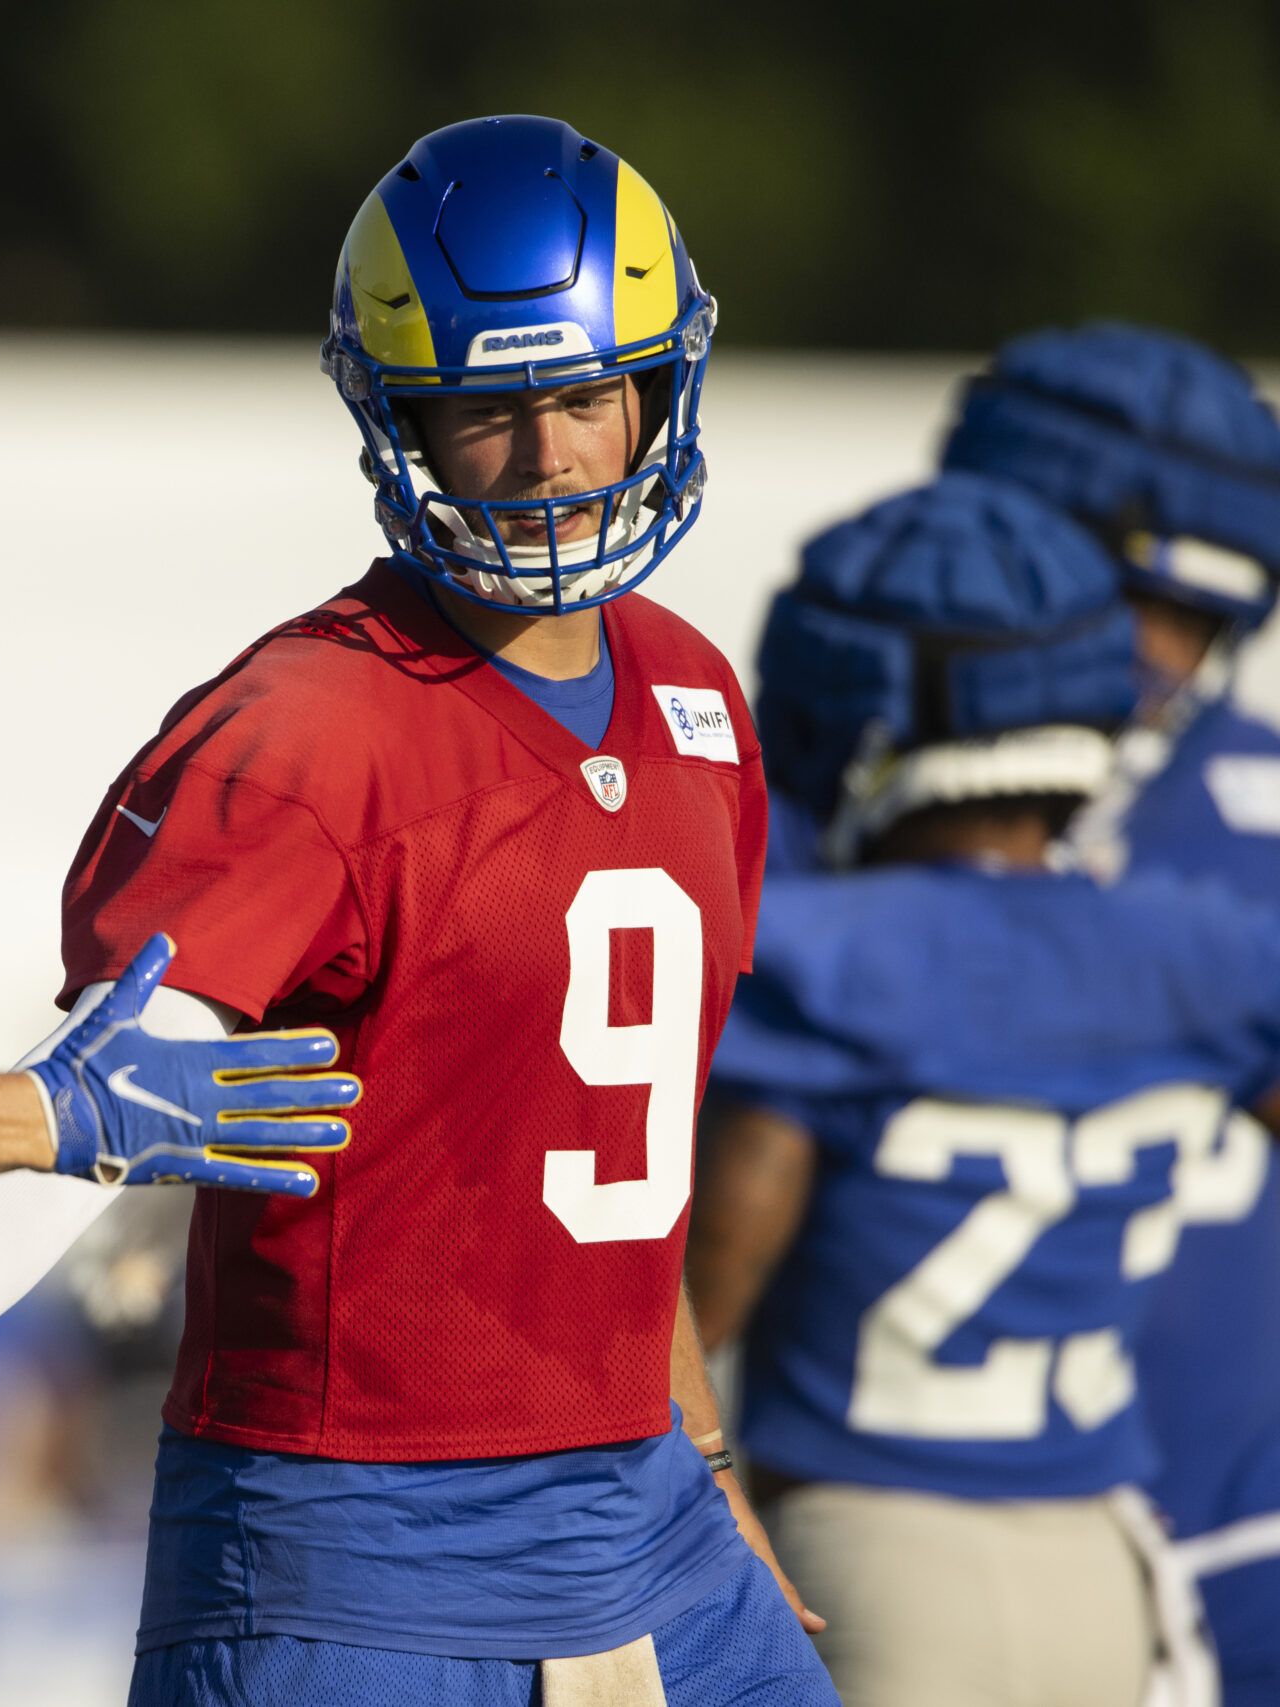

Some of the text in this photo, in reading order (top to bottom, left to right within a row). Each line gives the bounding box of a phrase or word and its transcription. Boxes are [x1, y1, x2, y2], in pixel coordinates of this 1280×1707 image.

[482, 330, 564, 353] RAMS
[691, 709, 729, 730] UNIFY
[603, 783, 619, 799] NFL
[542, 867, 703, 1244] 9
